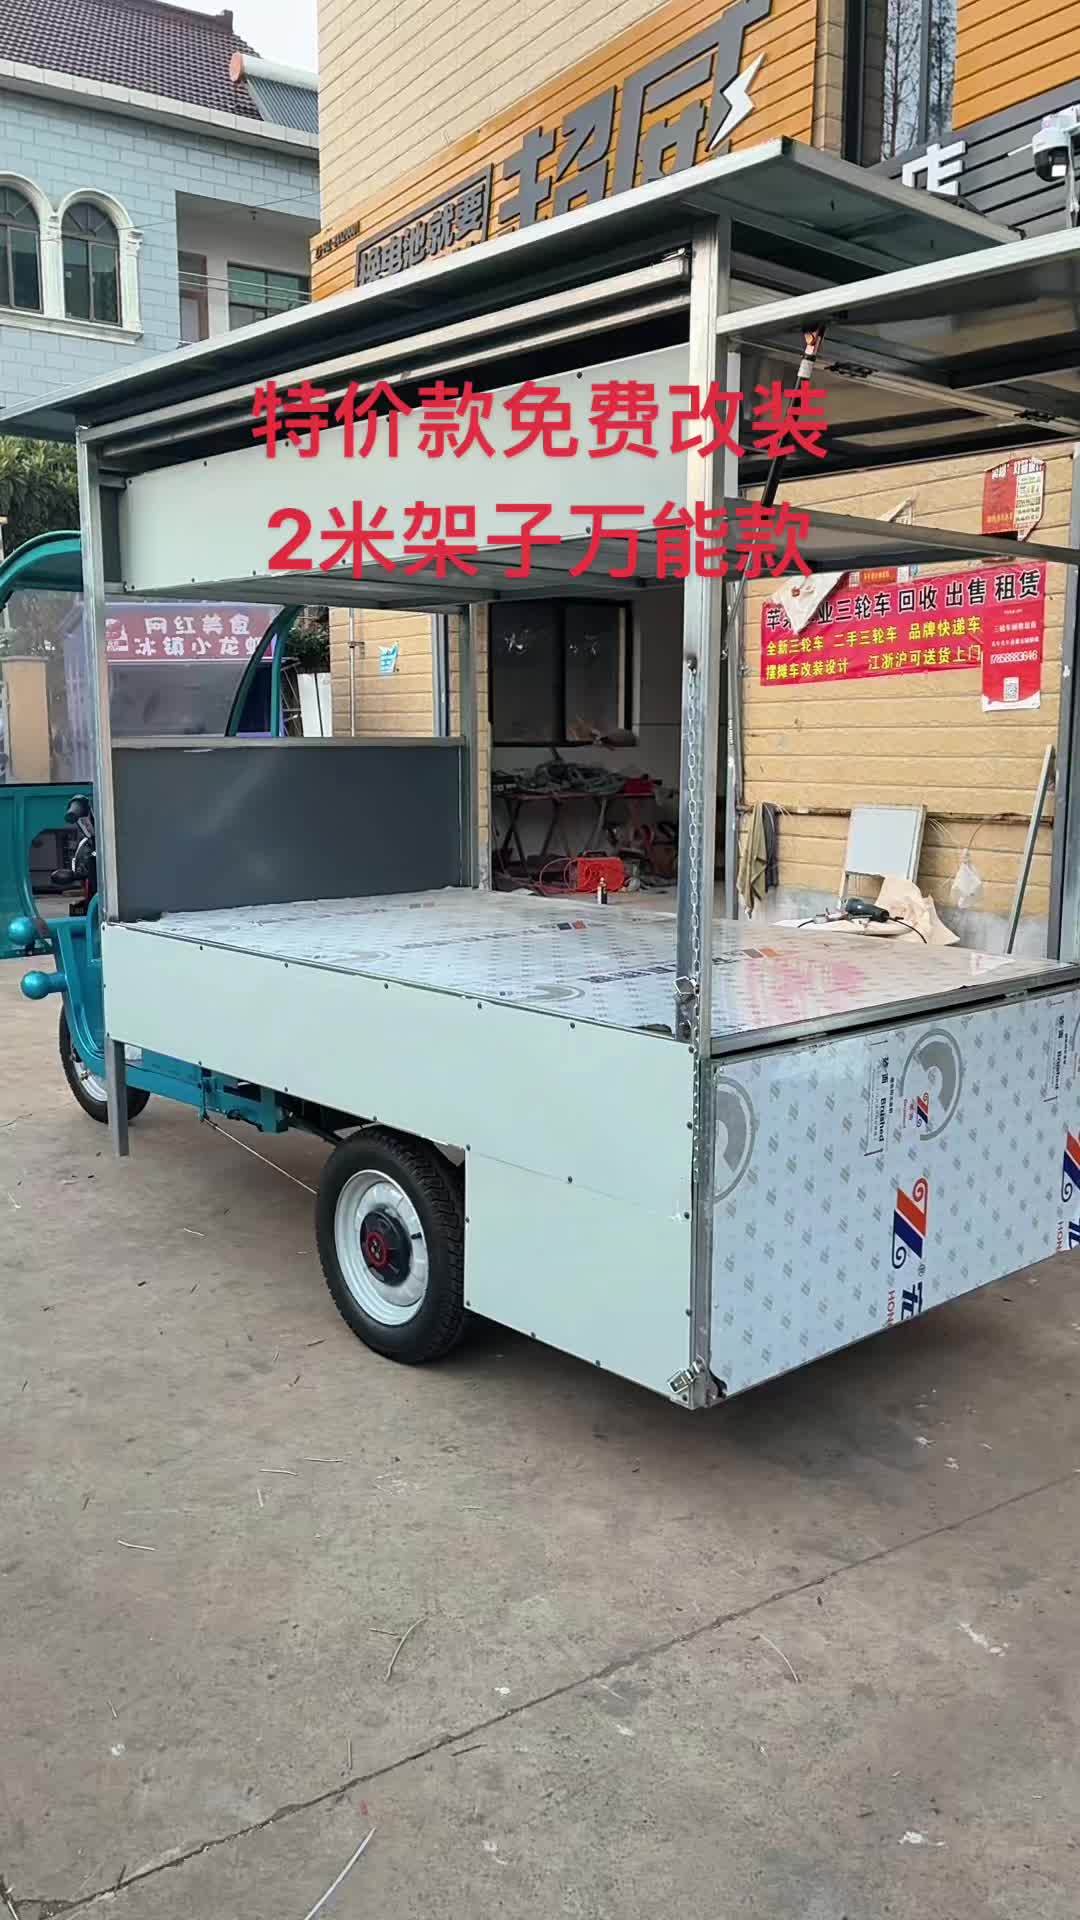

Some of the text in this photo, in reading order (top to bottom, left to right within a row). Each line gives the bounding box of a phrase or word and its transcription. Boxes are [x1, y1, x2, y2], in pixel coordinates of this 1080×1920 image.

[766, 570, 1040, 631] 苹业三轮车 回收 出售 租赁
[145, 613, 250, 636] 网红美食
[767, 616, 981, 656] 全新三轮车 二手三轮车 品牌快递车
[767, 644, 981, 680] 摆摊车改装设计 江浙沪可送货上门
